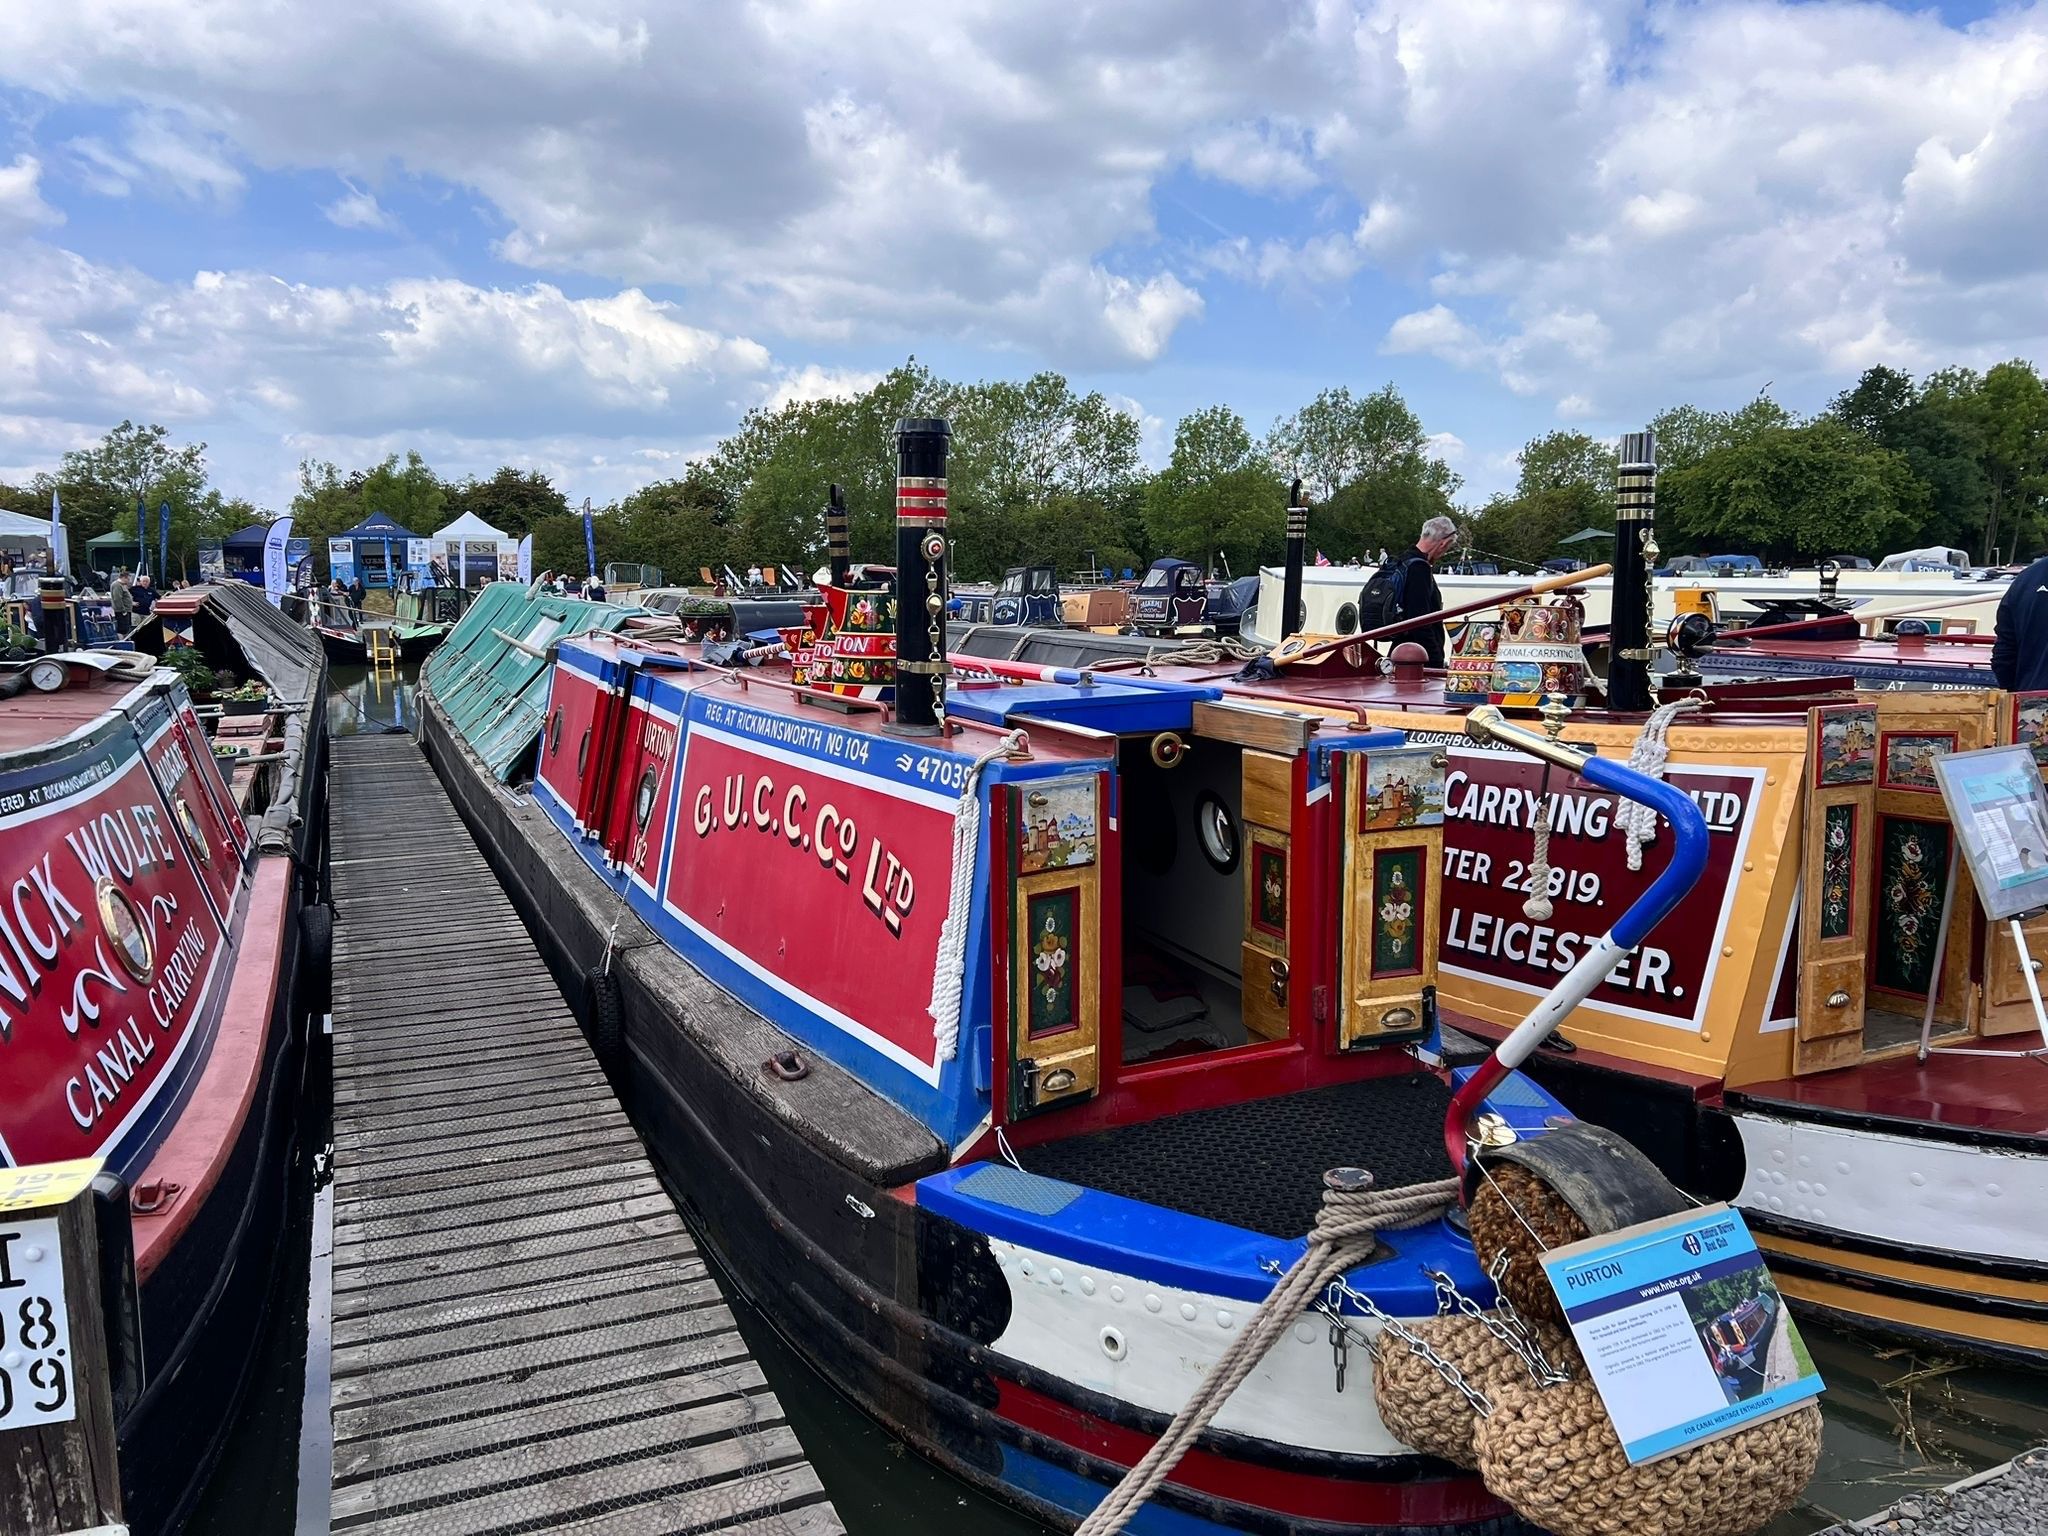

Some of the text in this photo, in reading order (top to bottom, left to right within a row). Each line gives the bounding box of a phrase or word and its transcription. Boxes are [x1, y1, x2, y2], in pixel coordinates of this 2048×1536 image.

[1887, 681, 1906, 691] AT
[705, 703, 723, 724] REG.
[724, 709, 736, 726] AT
[735, 711, 822, 750] RICKMANSWORTH
[846, 737, 869, 765] 104
[0, 793, 25, 815] ERED
[29, 788, 41, 805] AT
[1444, 770, 1612, 838] CARRYING
[65, 805, 175, 884] WOLFE
[1444, 846, 1491, 884] TER
[66, 1015, 155, 1128] CANAL
[149, 916, 206, 1028] CARRYING
[1566, 1261, 1624, 1290] PURTON
[1639, 1271, 1703, 1299] www.hnbc.org.uk
[1684, 1396, 1775, 1436] FOR CANAL HERITAGE ENTHUSIASTS
